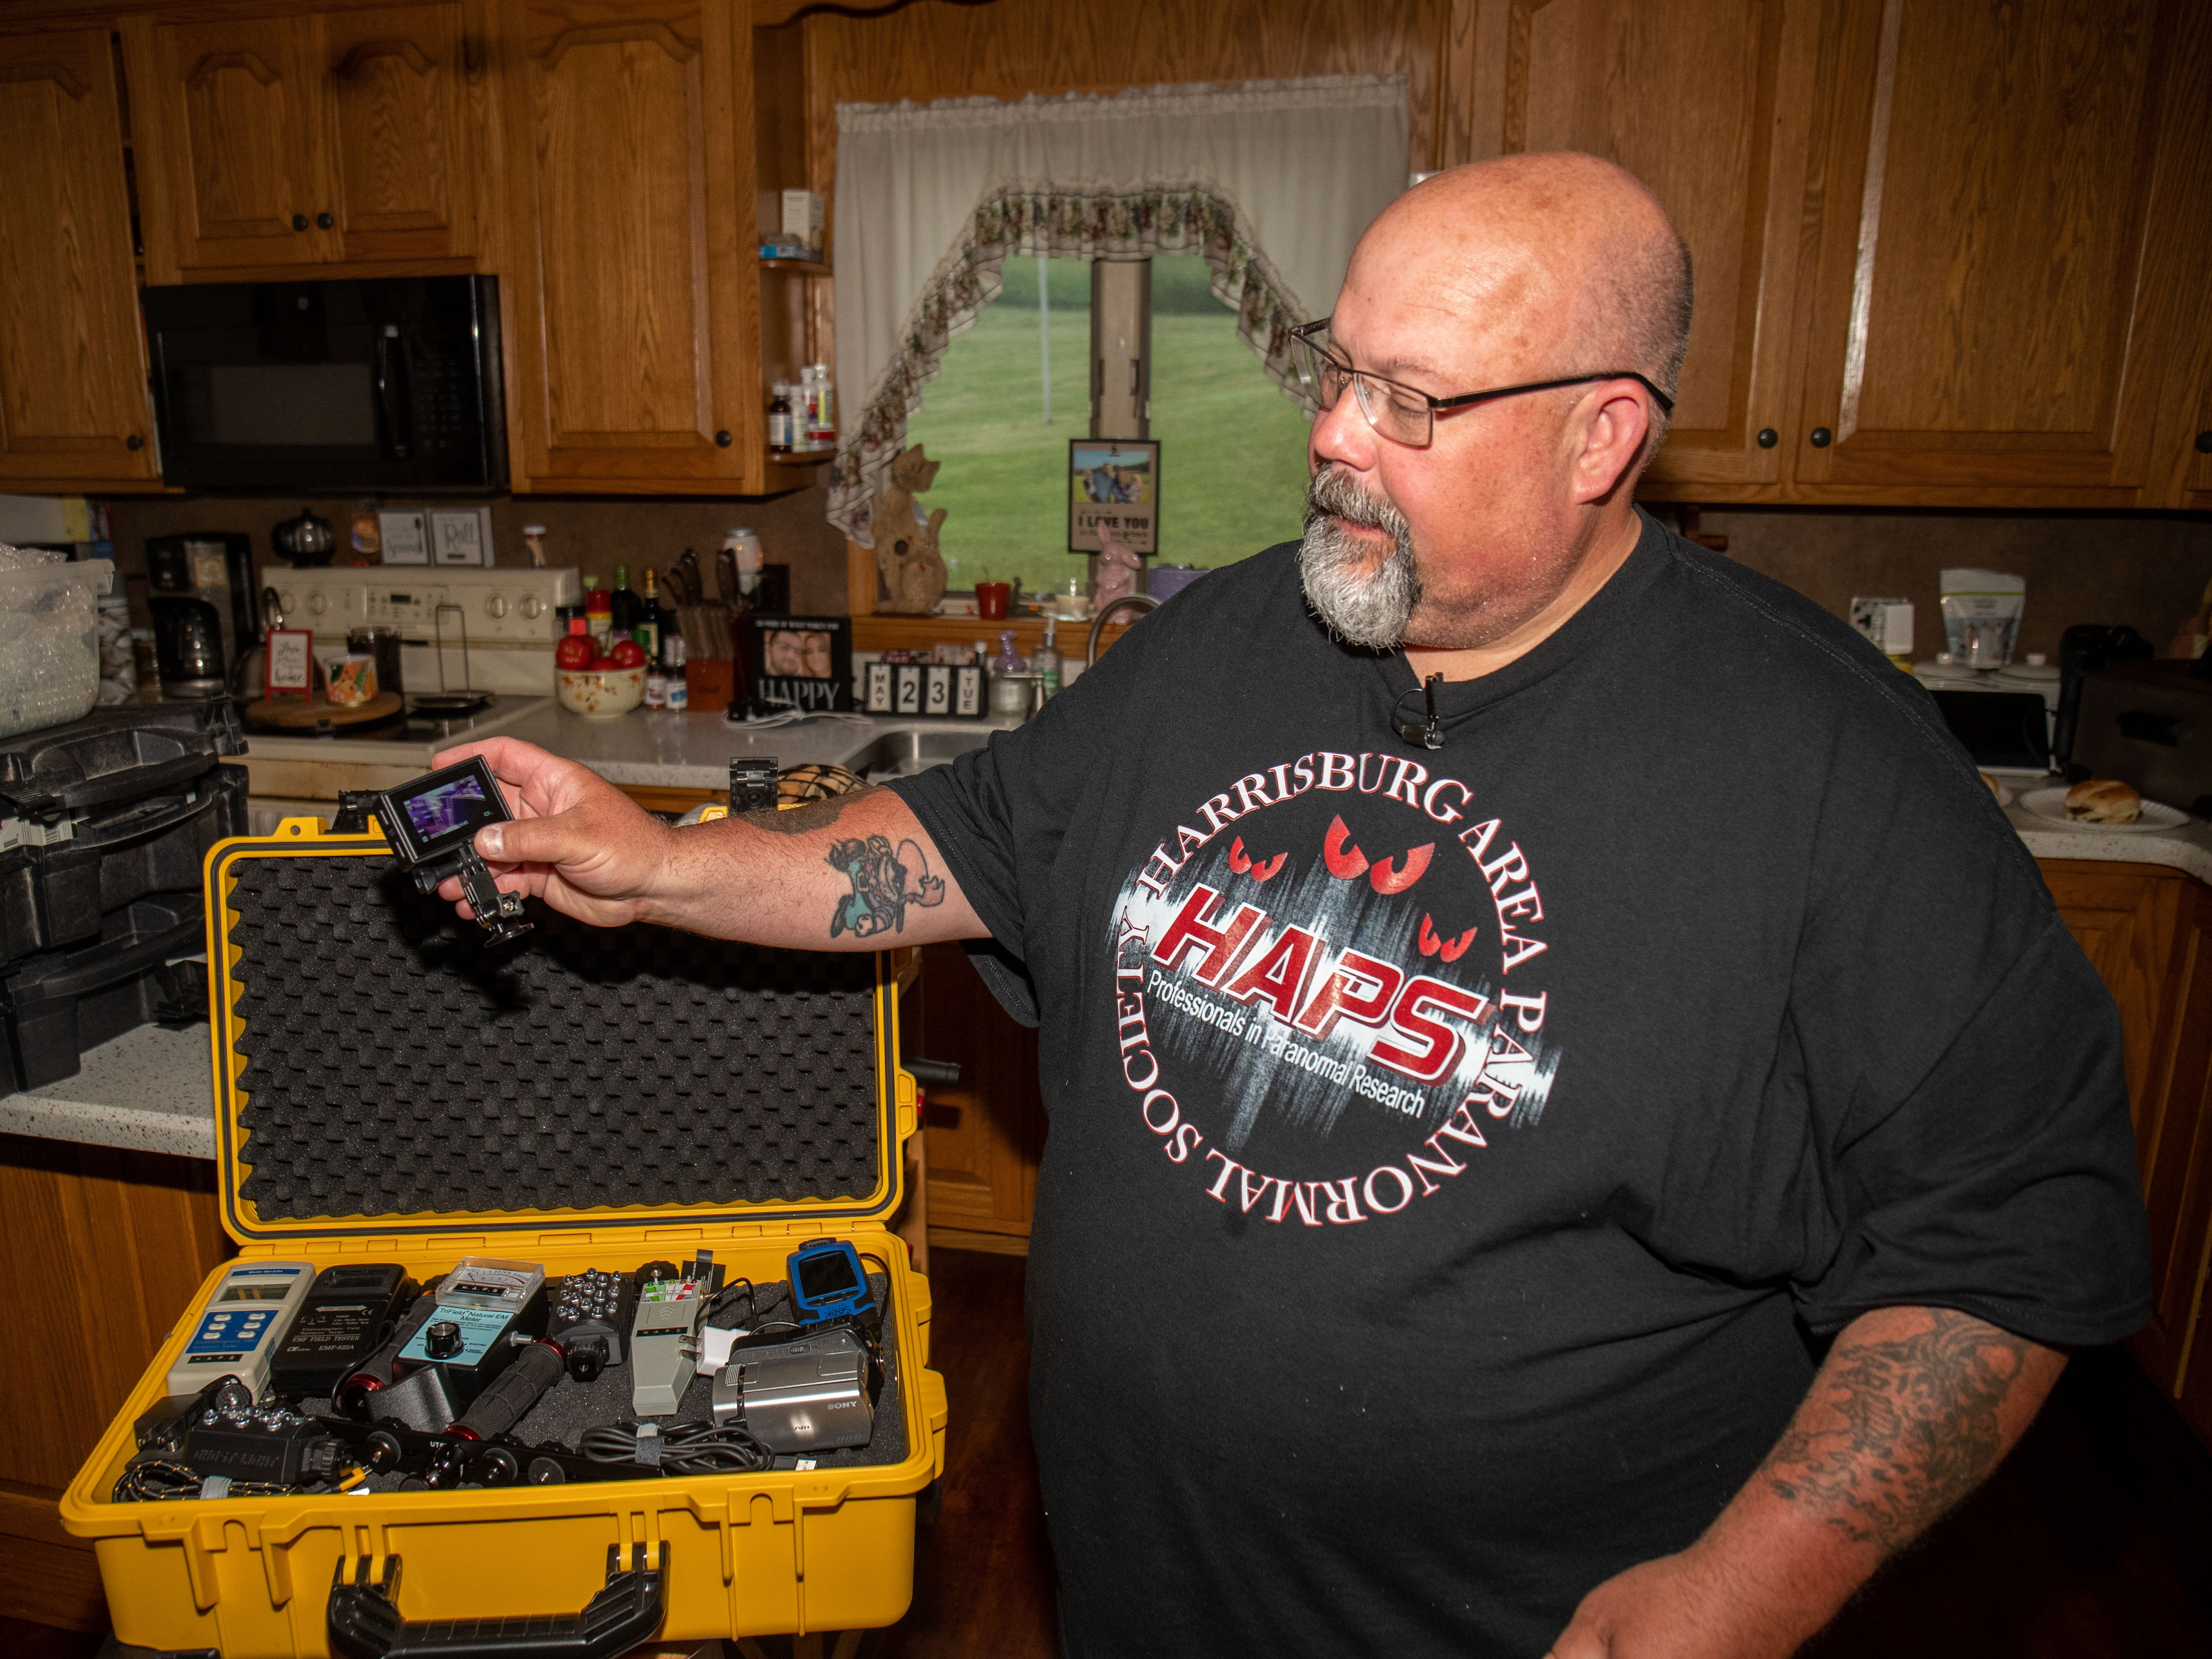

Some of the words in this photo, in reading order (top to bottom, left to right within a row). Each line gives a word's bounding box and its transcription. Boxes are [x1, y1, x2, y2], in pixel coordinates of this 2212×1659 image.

[1123, 517, 1149, 530] YOU
[758, 679, 840, 710] HAPPY
[875, 674, 885, 706] MAY
[962, 677, 974, 710] TUE
[1134, 751, 1474, 900] HARRISBURG
[1458, 818, 1548, 975] AREA
[1116, 905, 1204, 1164] SOCIETY
[1146, 970, 1247, 1037] Professionals
[1245, 1017, 1262, 1045] in
[1262, 1026, 1354, 1086] Paranormal
[1351, 1064, 1426, 1119] Research
[1150, 882, 1497, 1086] HAPS
[1205, 987, 1548, 1227] PARANORMAL
[823, 1306, 851, 1318] Seek
[827, 1400, 858, 1410] SONY
